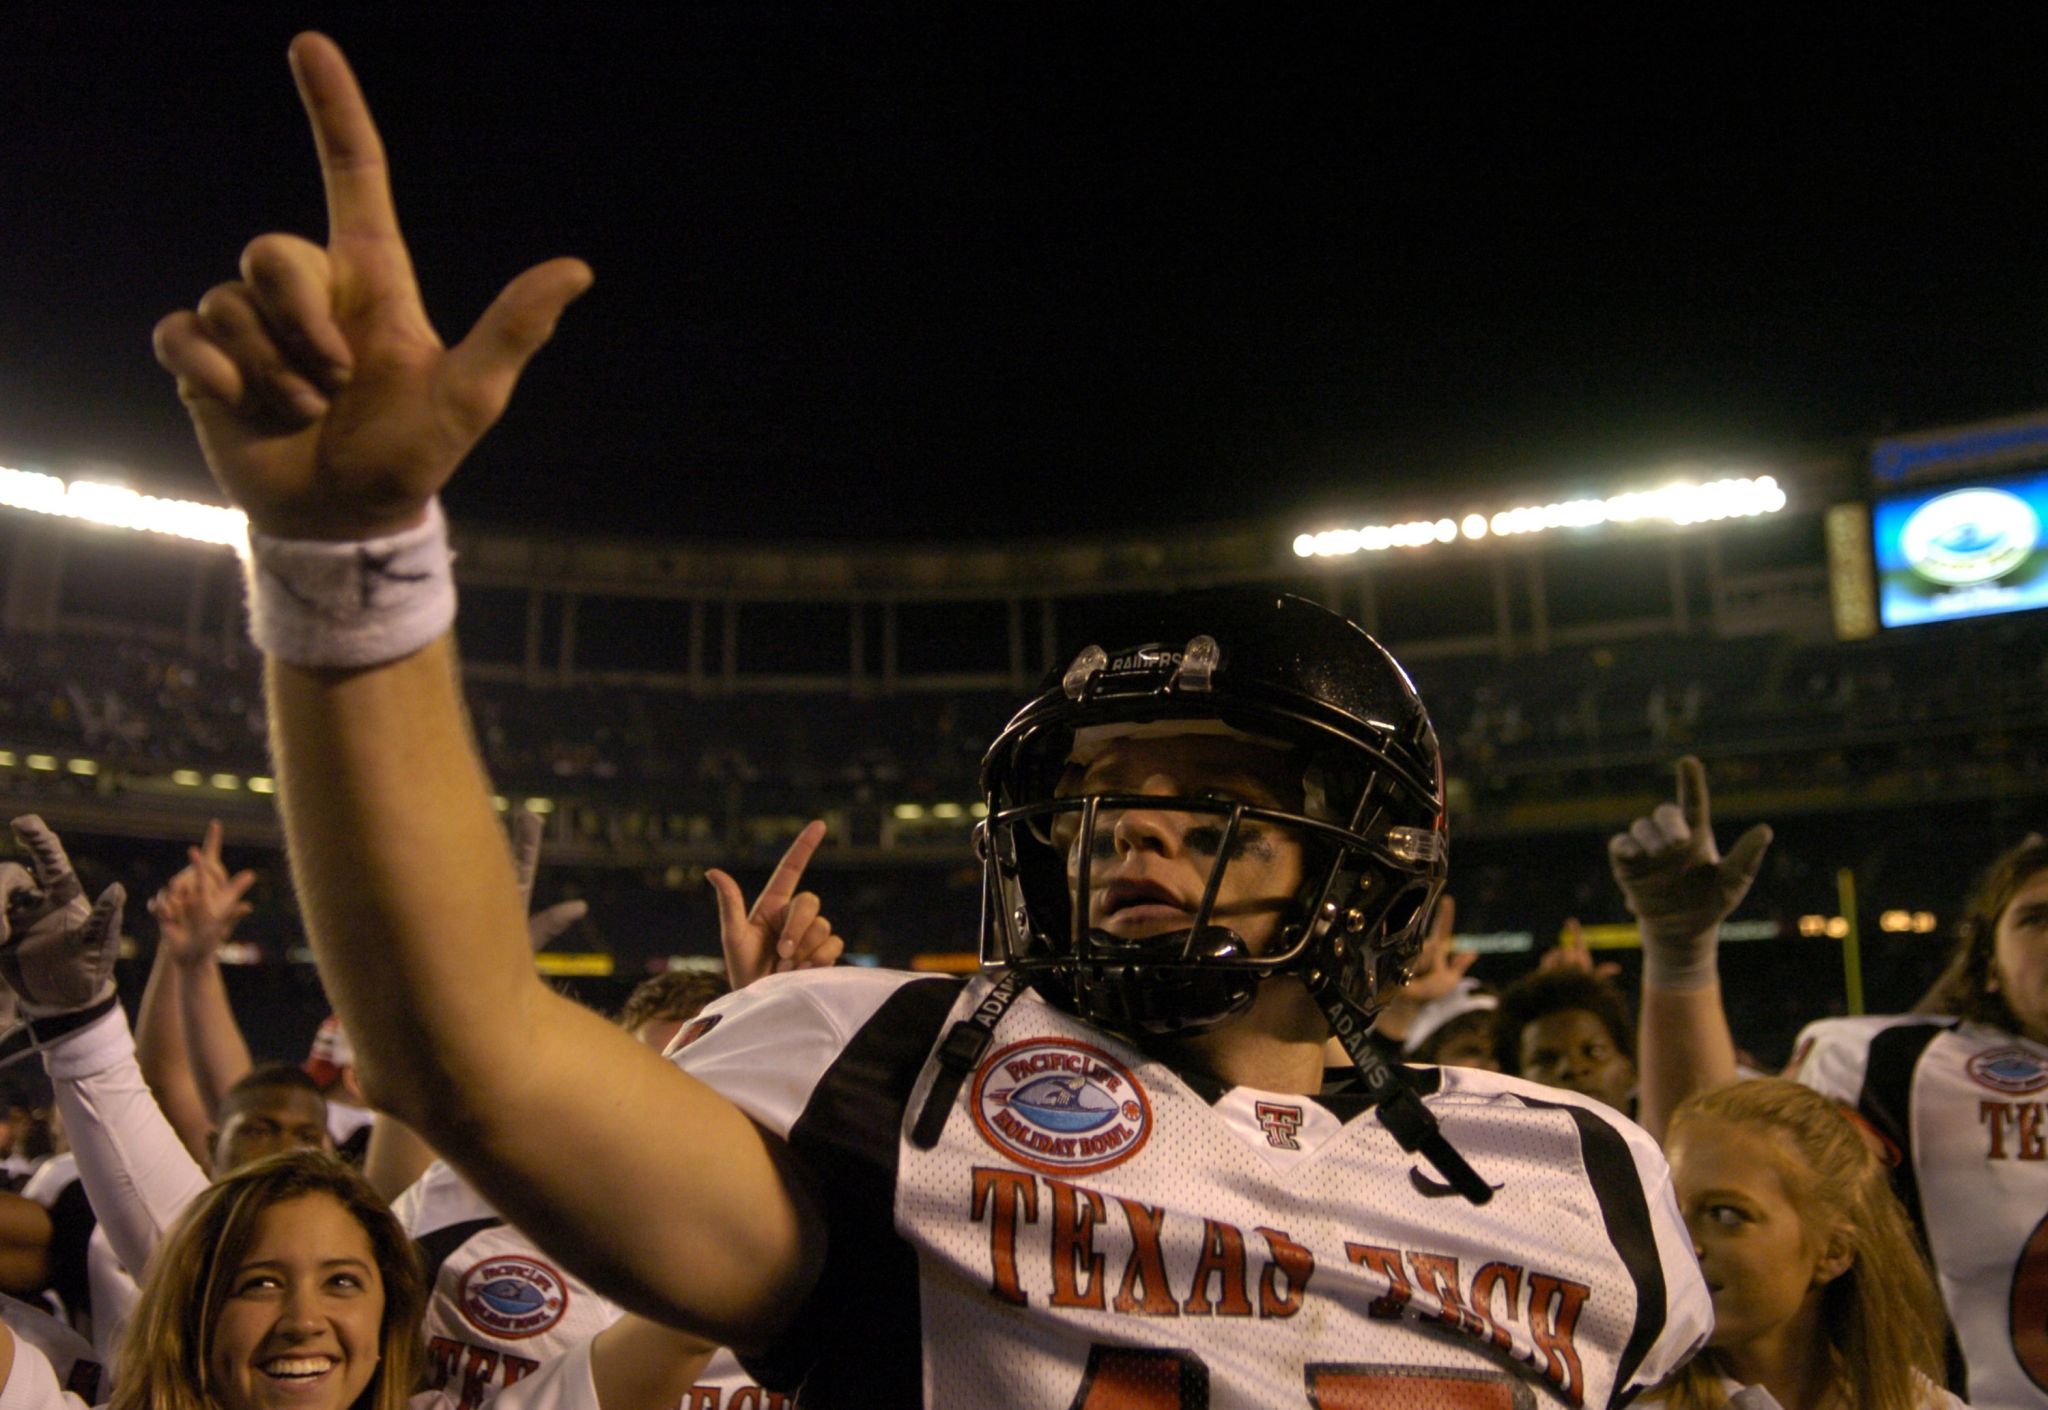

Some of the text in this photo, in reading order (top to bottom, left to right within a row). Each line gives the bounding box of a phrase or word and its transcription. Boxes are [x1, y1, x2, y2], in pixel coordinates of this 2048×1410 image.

[1005, 1052, 1123, 1094] PACIFIC LIFE
[1327, 1002, 1389, 1089] ADAMS
[991, 1108, 1134, 1158] HOLIDAY BOWL
[969, 1165, 1316, 1320] TEXAS
[1343, 1241, 1592, 1409] TECH
